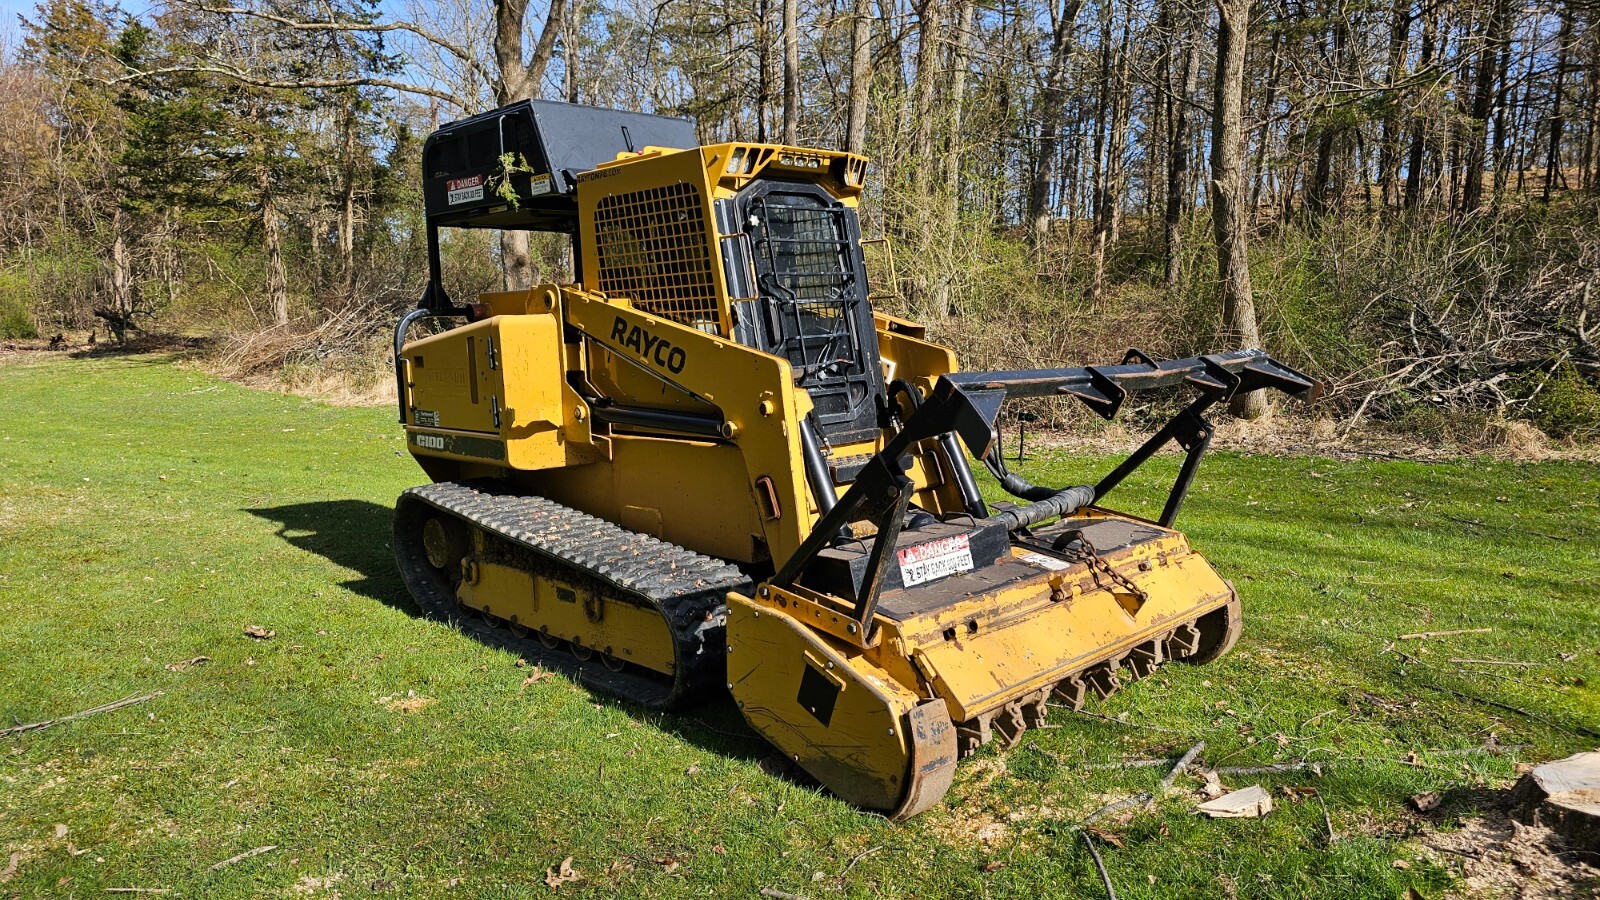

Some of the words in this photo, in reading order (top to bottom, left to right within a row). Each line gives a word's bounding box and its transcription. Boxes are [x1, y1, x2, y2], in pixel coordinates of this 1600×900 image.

[456, 176, 480, 189] DANGER
[610, 315, 687, 375] RAYCO
[416, 434, 444, 449] C100
[918, 537, 963, 559] DANGER
[915, 563, 930, 579] STAY
[930, 559, 946, 575] BACK
[957, 553, 970, 568] FEET
